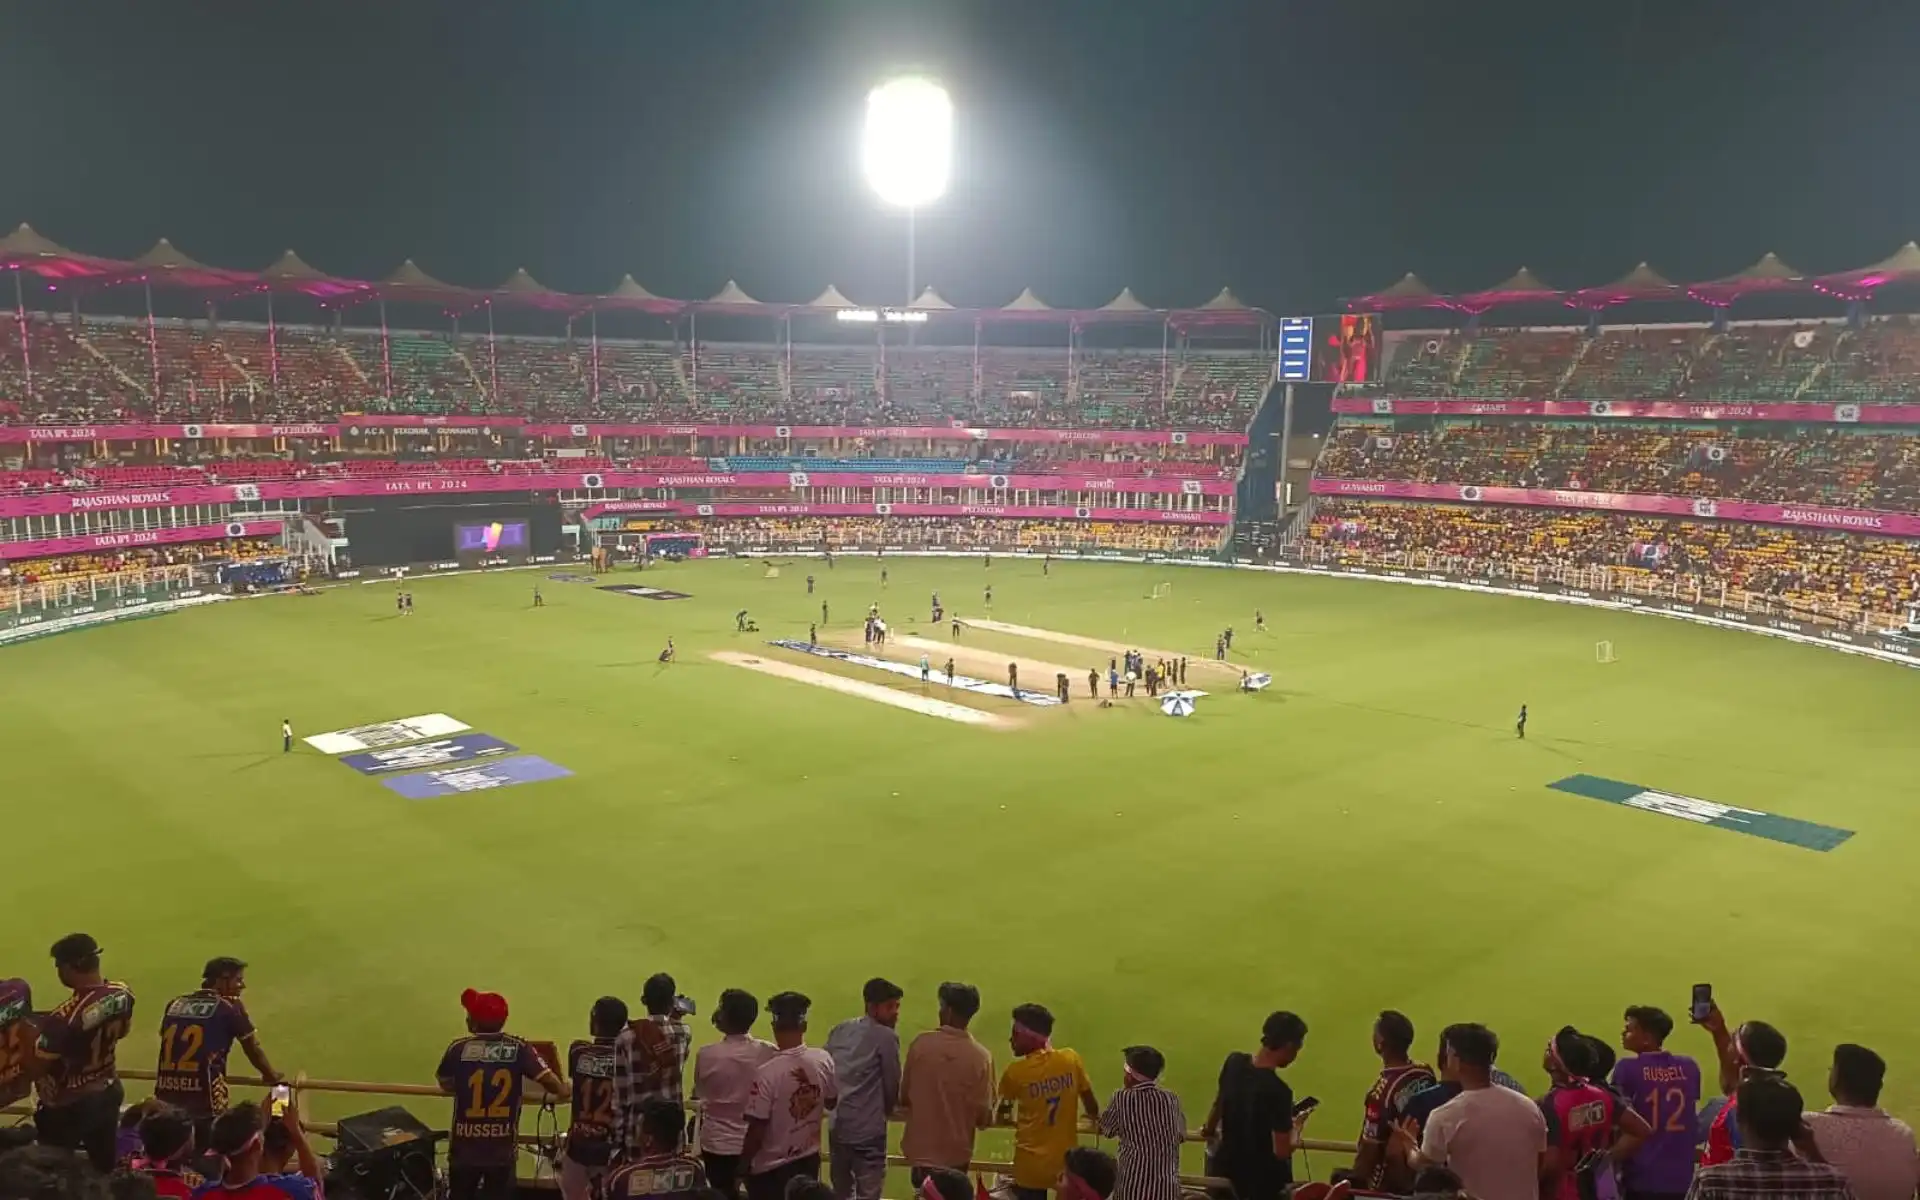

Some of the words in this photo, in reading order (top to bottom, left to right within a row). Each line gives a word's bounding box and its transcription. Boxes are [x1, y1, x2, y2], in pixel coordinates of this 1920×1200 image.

[29, 429, 54, 438] TATA
[54, 429, 69, 438] IPL
[71, 428, 96, 437] 2024
[385, 482, 411, 491] TATA
[417, 482, 433, 490] IPL
[440, 480, 467, 489] 2024
[658, 476, 704, 485] RAJASTHAN
[705, 475, 736, 484] ROYALS
[1340, 483, 1385, 492] GUWAHATI
[72, 493, 131, 508] RAJASTHAN
[132, 491, 170, 504] ROYALS
[1783, 508, 1841, 523] RAJASTHAN
[1842, 515, 1883, 527] ROYALS
[95, 536, 116, 546] TATA
[134, 533, 157, 542] 2024
[1725, 612, 1747, 621] NEOM
[1885, 642, 1908, 654] NEOM
[163, 1023, 204, 1070] 12
[463, 1042, 517, 1061] BKT
[1643, 1065, 1688, 1083] RUSSELL
[158, 1075, 203, 1091] USSELL
[1029, 1072, 1073, 1098] DHONI
[465, 1068, 513, 1118] 12
[579, 1078, 613, 1122] 12
[1046, 1097, 1061, 1126] 7
[1645, 1087, 1687, 1132] 12
[456, 1122, 511, 1138] RUSSELL
[630, 1170, 692, 1194] BKT
